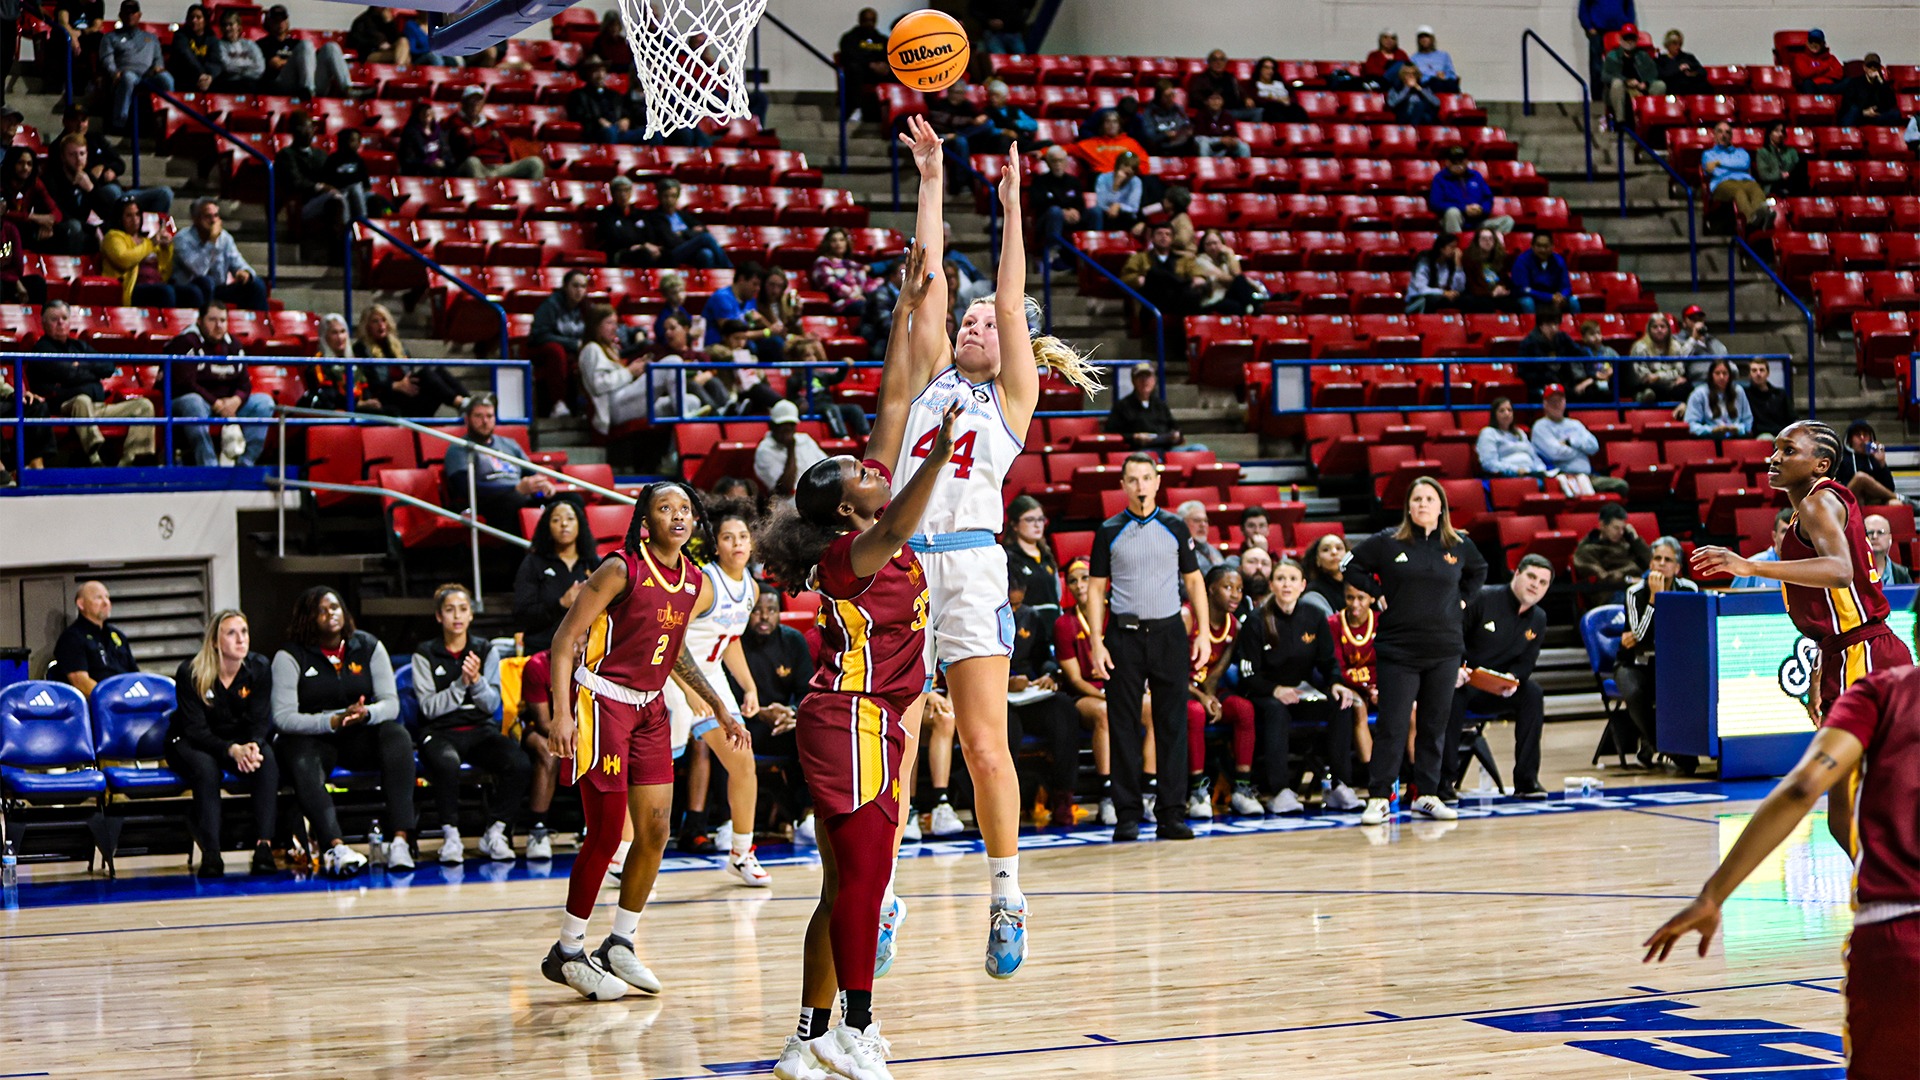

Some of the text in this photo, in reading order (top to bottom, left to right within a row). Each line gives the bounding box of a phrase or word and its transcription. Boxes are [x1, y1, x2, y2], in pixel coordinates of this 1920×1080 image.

[899, 44, 953, 65] Wilson
[911, 424, 977, 480] 44
[651, 634, 669, 665] 2
